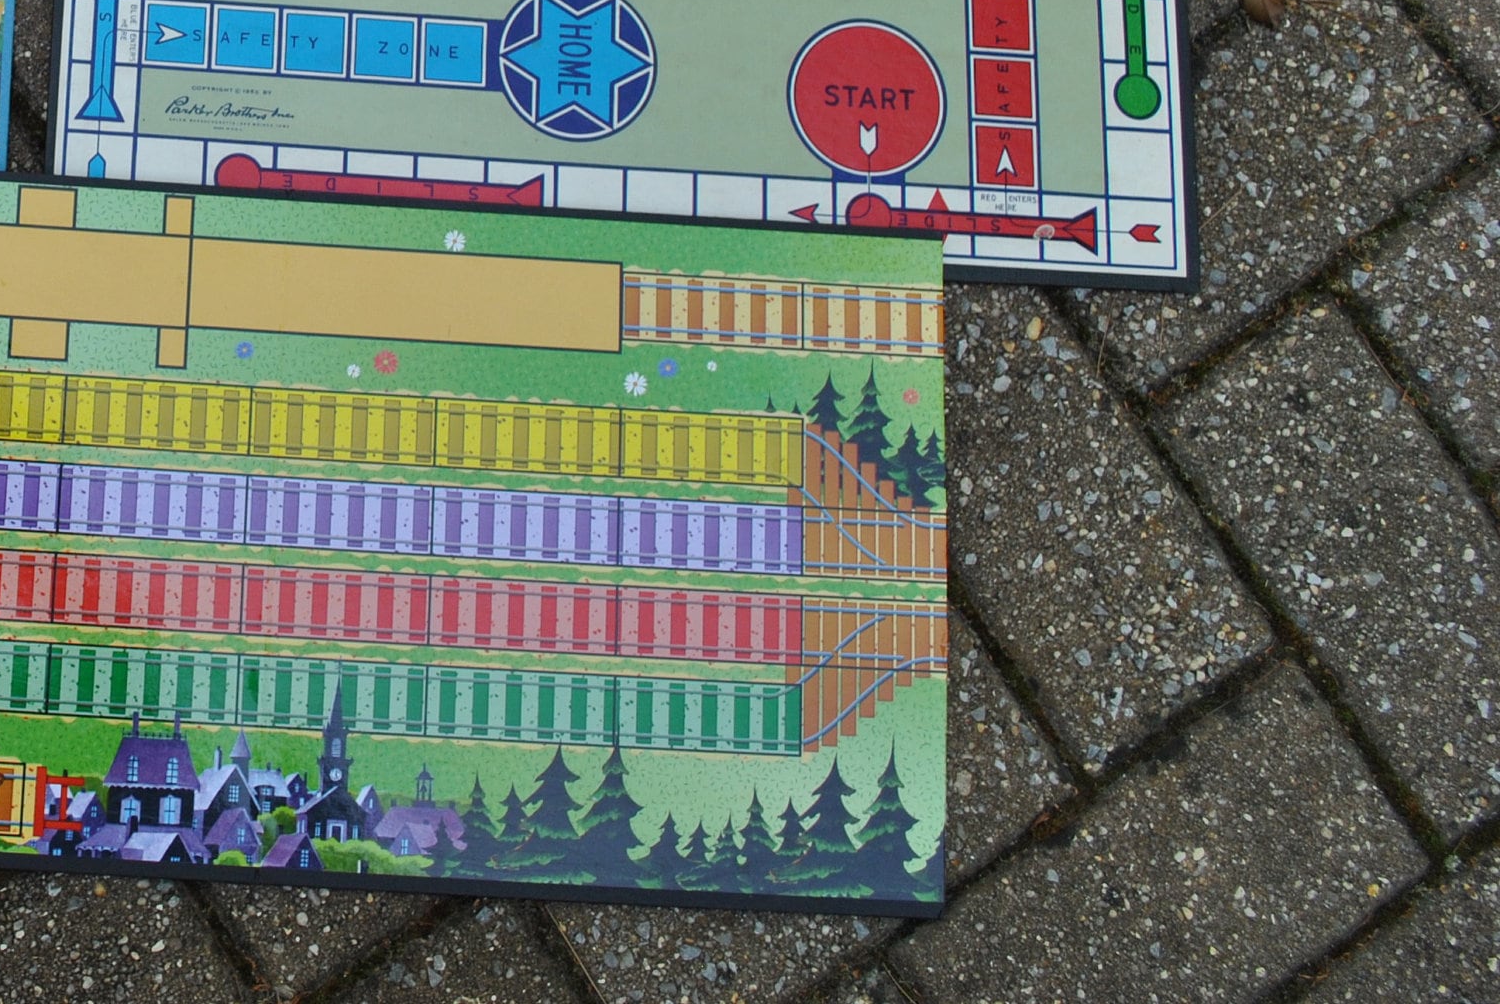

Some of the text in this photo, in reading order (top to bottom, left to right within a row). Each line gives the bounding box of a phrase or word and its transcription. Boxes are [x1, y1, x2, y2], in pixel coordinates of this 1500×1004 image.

[192, 29, 460, 59] SAFETY ZONE
[557, 23, 592, 96] HOME
[995, 16, 1011, 140] SAFETY
[165, 95, 214, 117] Parker
[824, 84, 915, 111] START
[282, 174, 478, 200] SLIDE
[980, 193, 1037, 204] RED ENTERS
[995, 203, 1017, 212] HERE
[897, 213, 1001, 232] SLIDE
